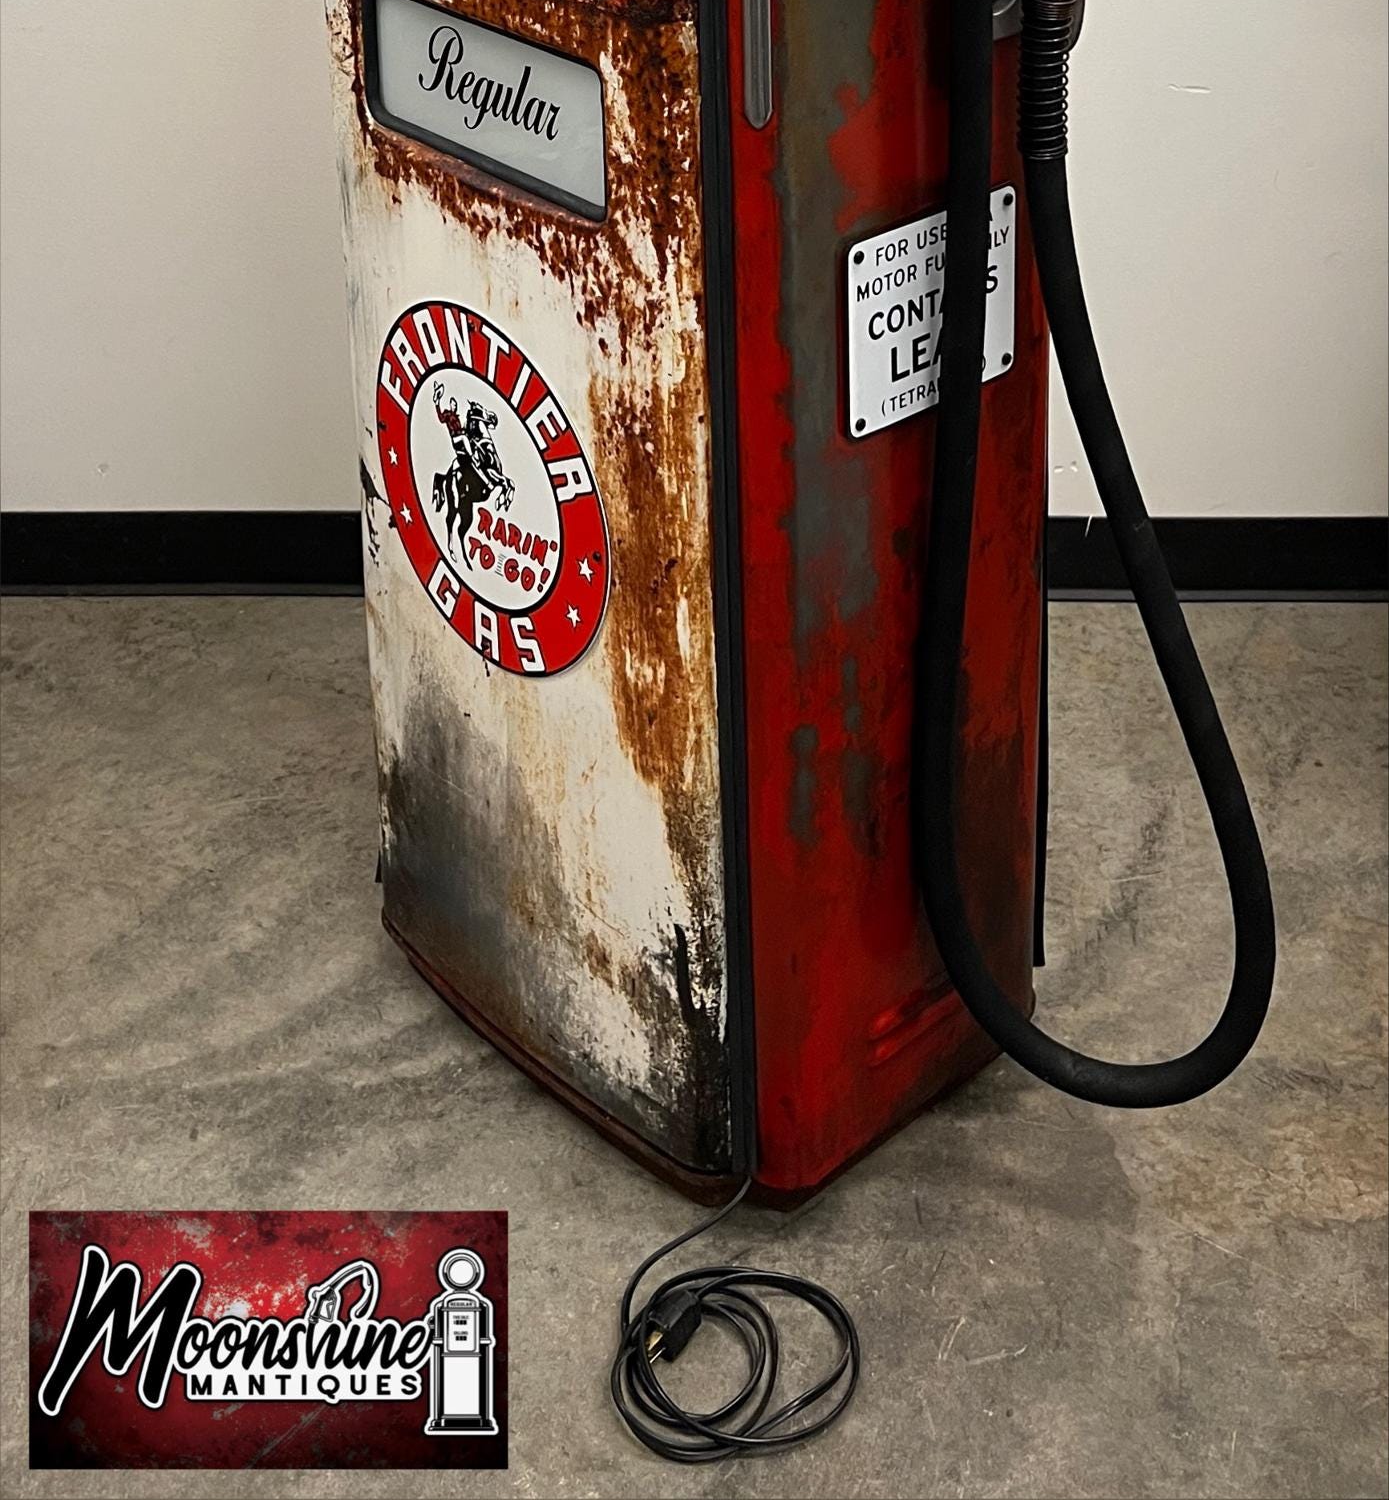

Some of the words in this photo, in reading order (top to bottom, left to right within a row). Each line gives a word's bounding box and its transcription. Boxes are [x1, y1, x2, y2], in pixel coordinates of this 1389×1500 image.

[418, 25, 561, 141] Regular
[875, 238, 909, 267] FOR
[916, 223, 946, 250] USE
[856, 263, 917, 303] MOTOR
[925, 251, 946, 276] FU
[380, 306, 593, 503] FRONTIER
[468, 535, 496, 570] TO
[503, 558, 551, 593] GO!
[477, 506, 558, 567] RARIN'
[428, 558, 546, 672] GAS
